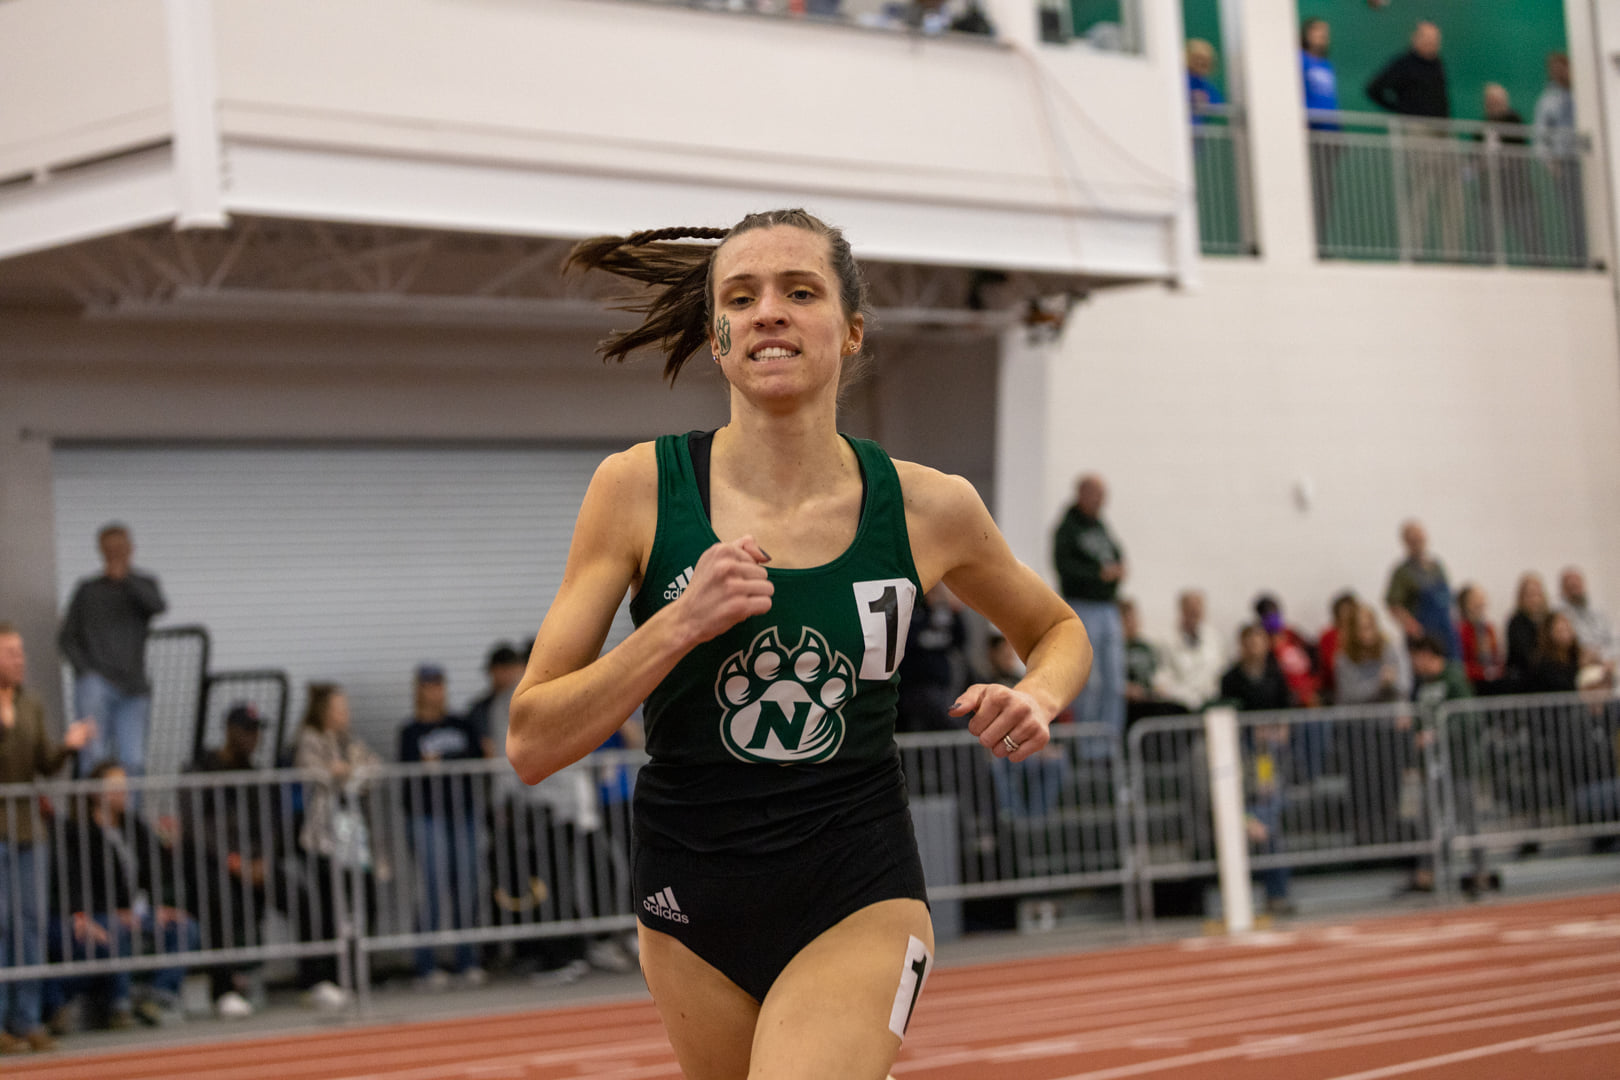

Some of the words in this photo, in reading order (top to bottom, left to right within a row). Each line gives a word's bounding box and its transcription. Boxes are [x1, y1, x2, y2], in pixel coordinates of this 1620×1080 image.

[868, 585, 898, 673] 1
[744, 700, 813, 751] N
[643, 899, 689, 924] adidas
[903, 954, 927, 1036] 1
